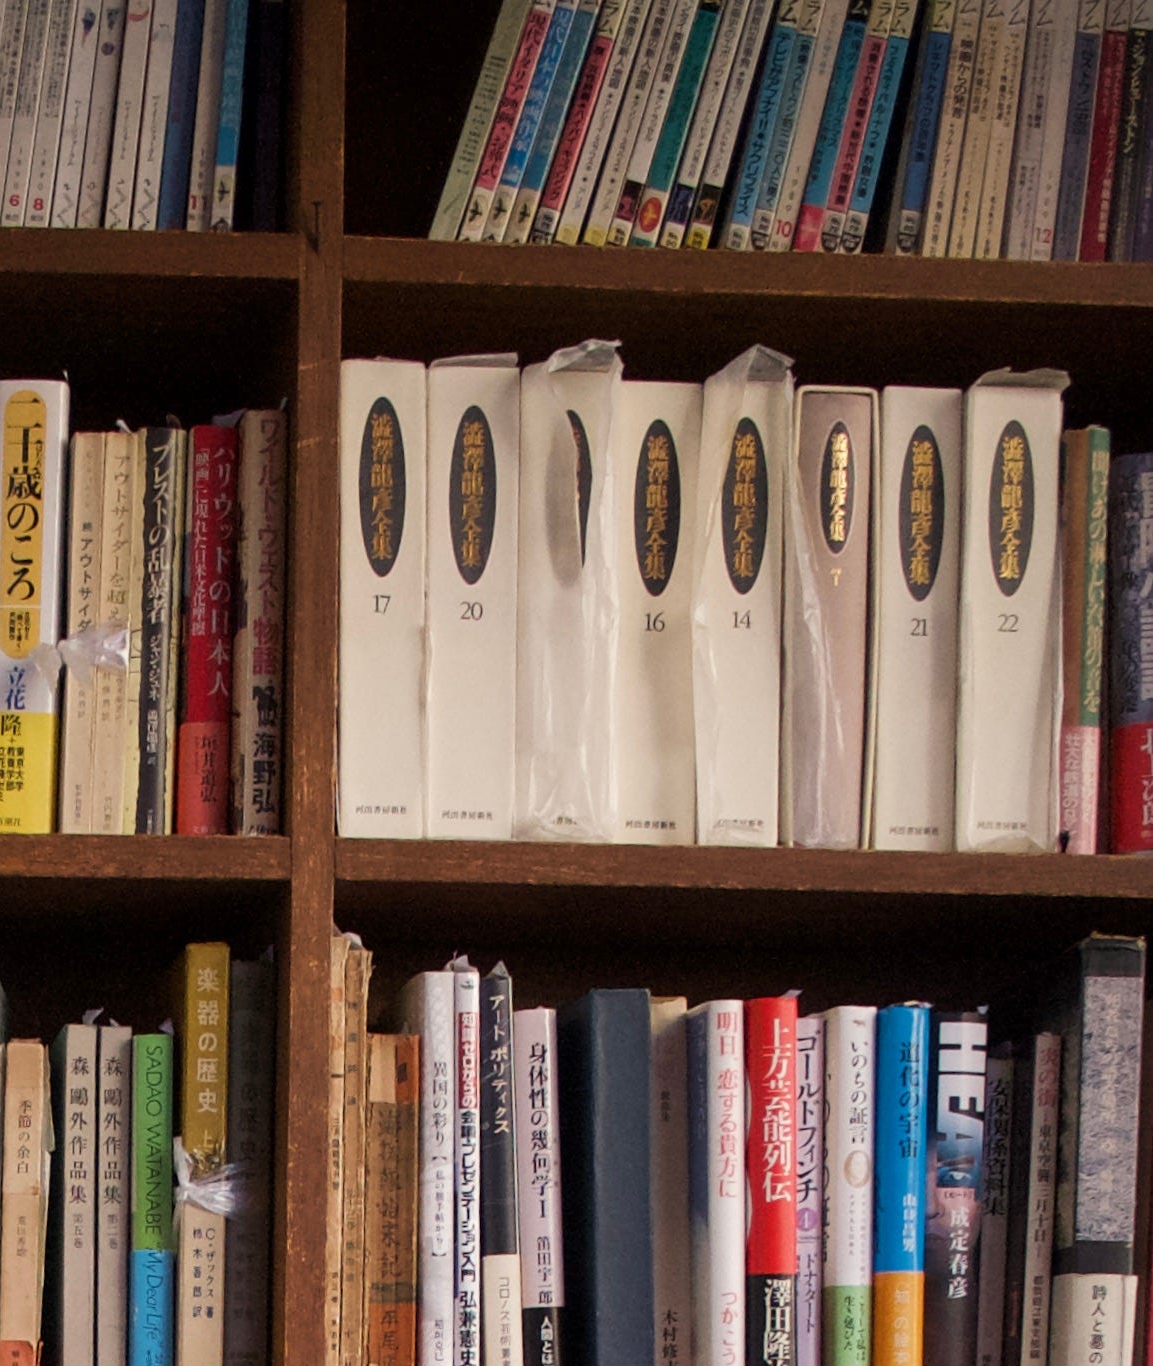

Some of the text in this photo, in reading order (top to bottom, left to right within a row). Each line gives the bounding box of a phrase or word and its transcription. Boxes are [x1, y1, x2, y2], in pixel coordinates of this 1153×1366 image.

[8, 193, 20, 207] 6
[774, 218, 792, 237] 10
[6, 396, 42, 600] 二十歳のころ
[206, 448, 235, 697] ハリウッドの日本人
[373, 595, 391, 615] 17
[460, 602, 484, 621] 20
[644, 613, 665, 632] 16
[731, 610, 752, 629] 14
[910, 618, 928, 637] 21
[998, 614, 1019, 633] 22
[252, 731, 277, 814] 海野弘
[197, 968, 218, 1114] 楽器の歴史
[488, 993, 509, 1134] アート ポリティクス
[432, 1061, 448, 1148] 異国の彩り
[762, 1019, 792, 1203] 上方芸能列伝
[796, 1032, 822, 1207] ゴールドフィンチ
[849, 1040, 869, 1145] いのちの証言
[898, 1041, 920, 1160] 道化の宇宙
[145, 1045, 163, 1234] SADAO WATANABE
